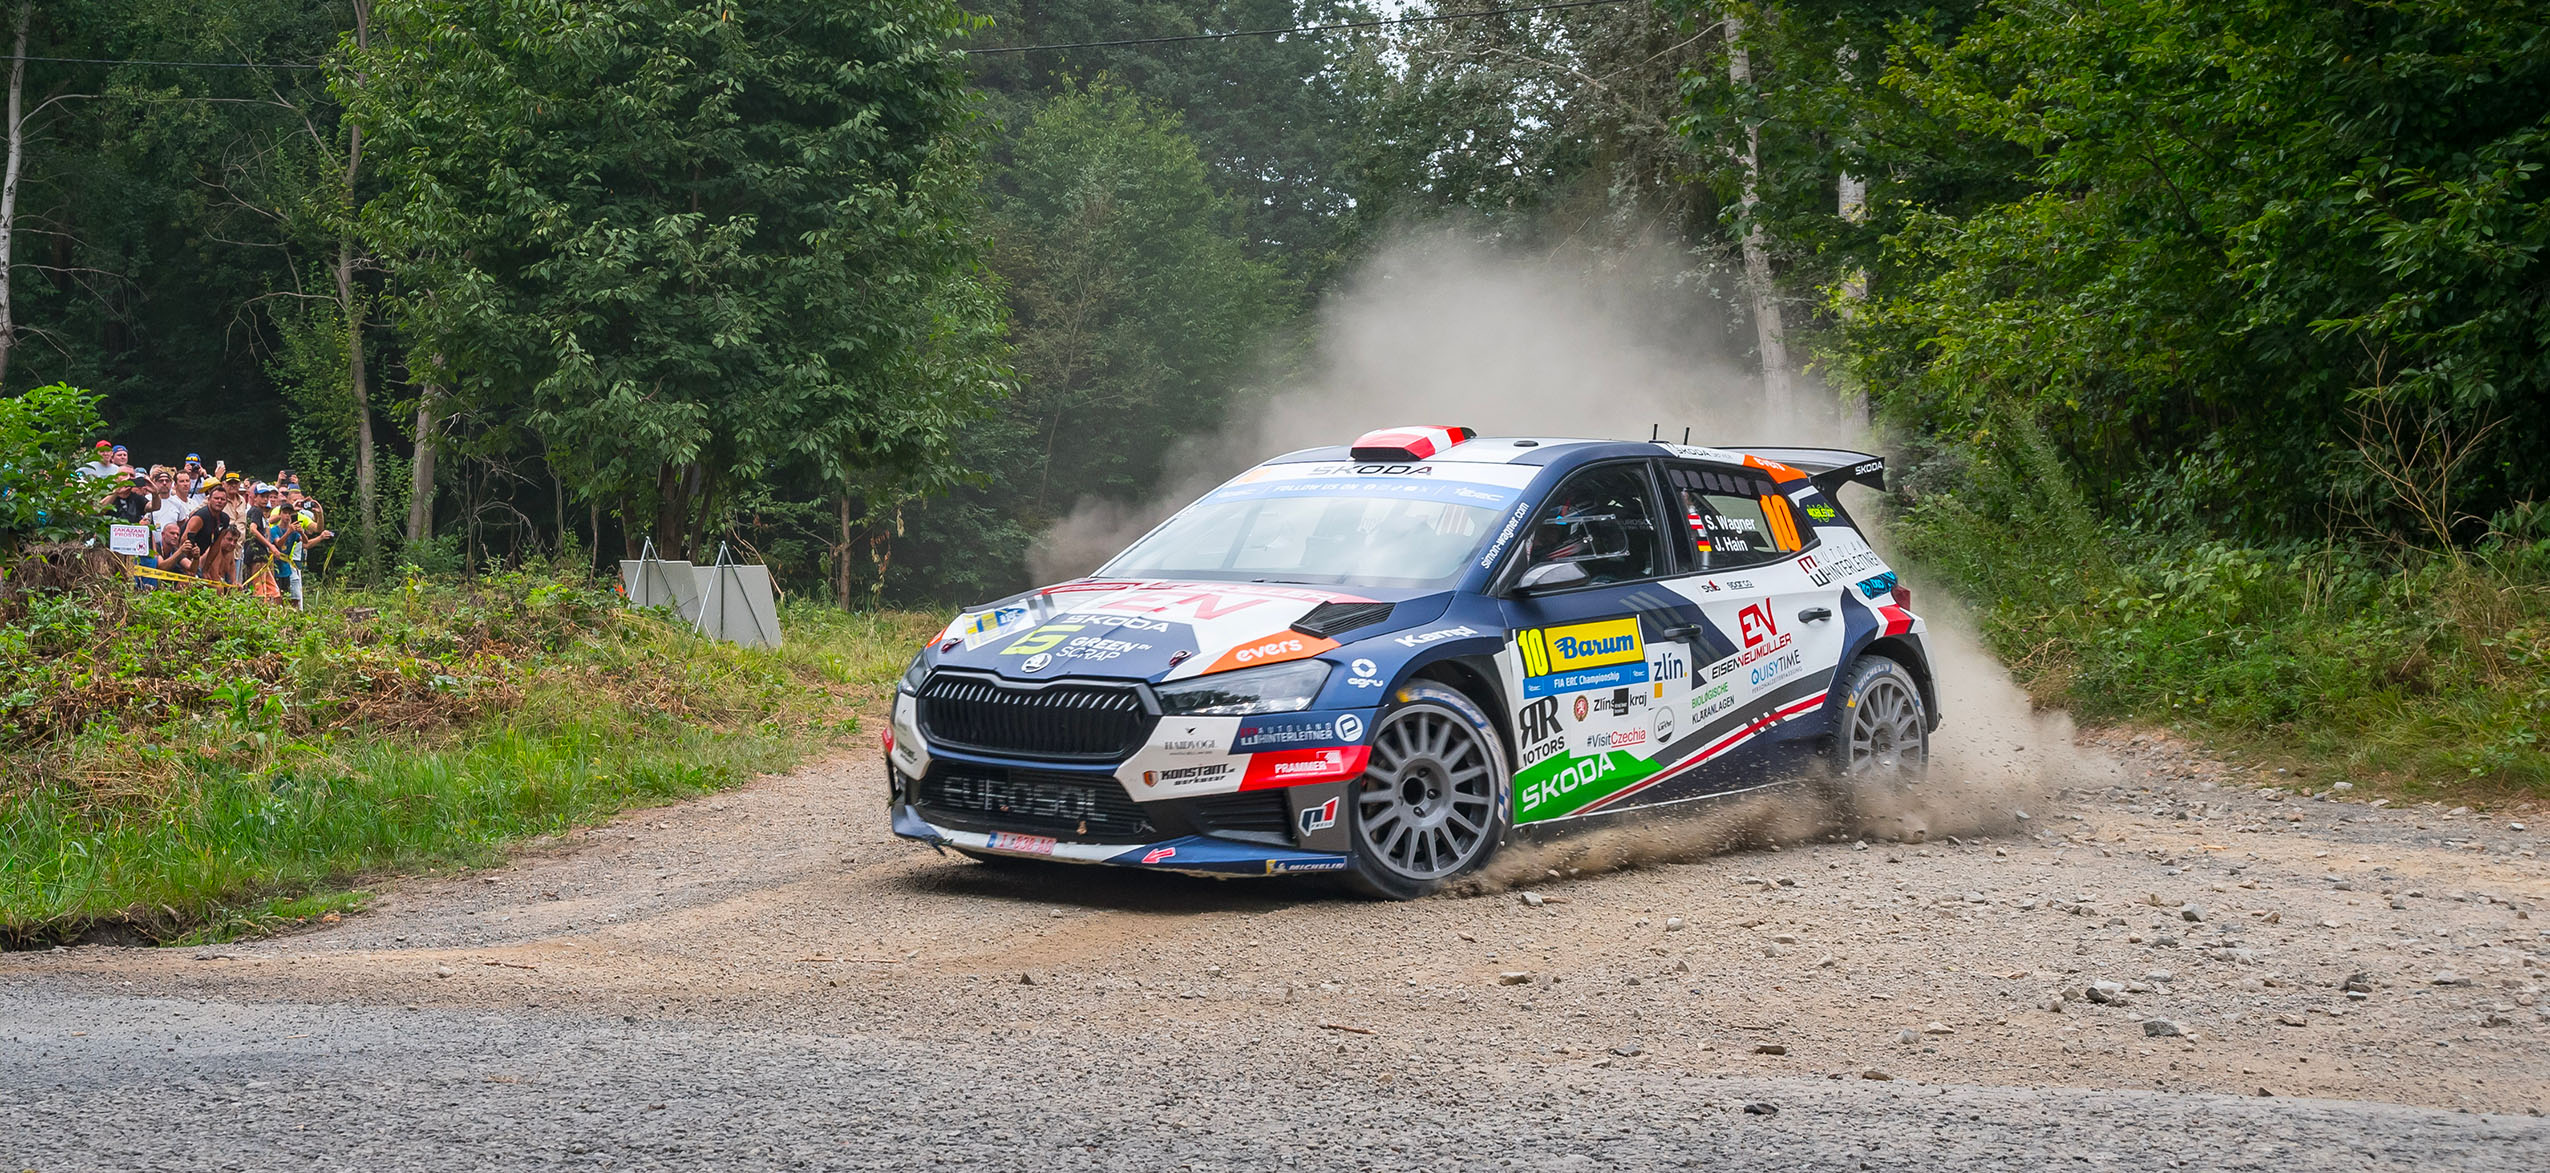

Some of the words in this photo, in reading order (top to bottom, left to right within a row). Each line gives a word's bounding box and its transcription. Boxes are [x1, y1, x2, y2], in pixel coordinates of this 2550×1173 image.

[1307, 465, 1433, 476] SKODA
[1855, 461, 1883, 476] SKODA
[1705, 516, 1719, 530] S.
[1720, 514, 1756, 534] Wagner
[1760, 494, 1802, 552] 10
[1481, 502, 1529, 569] simon-wagner.com
[1715, 537, 1724, 551] J.
[1724, 536, 1748, 551] Hain
[1061, 615, 1180, 633] SKODA
[1738, 597, 1778, 649] EN
[1070, 637, 1140, 653] GREEN
[1394, 626, 1479, 648] Kampl
[1056, 646, 1121, 662] SCRAP
[1236, 639, 1303, 662] evers
[1518, 629, 1549, 678] 10
[1554, 634, 1635, 660] Barum
[1751, 649, 1801, 685] QUISYTIME
[1347, 677, 1384, 688] agru
[1554, 678, 1565, 689] FIA
[1566, 676, 1579, 687] ERC
[1579, 671, 1620, 686] Championship
[1630, 692, 1648, 707] kraj
[1692, 682, 1728, 709] BIOLOGISCHE
[1257, 730, 1334, 744] HINTERLEITNER
[1587, 728, 1646, 747] #VisitCzechia
[1275, 761, 1328, 775] PRAMMER
[1523, 752, 1617, 813] SKODA
[944, 776, 1108, 822] EUROSOL
[1288, 862, 1345, 871] MICHELIN
